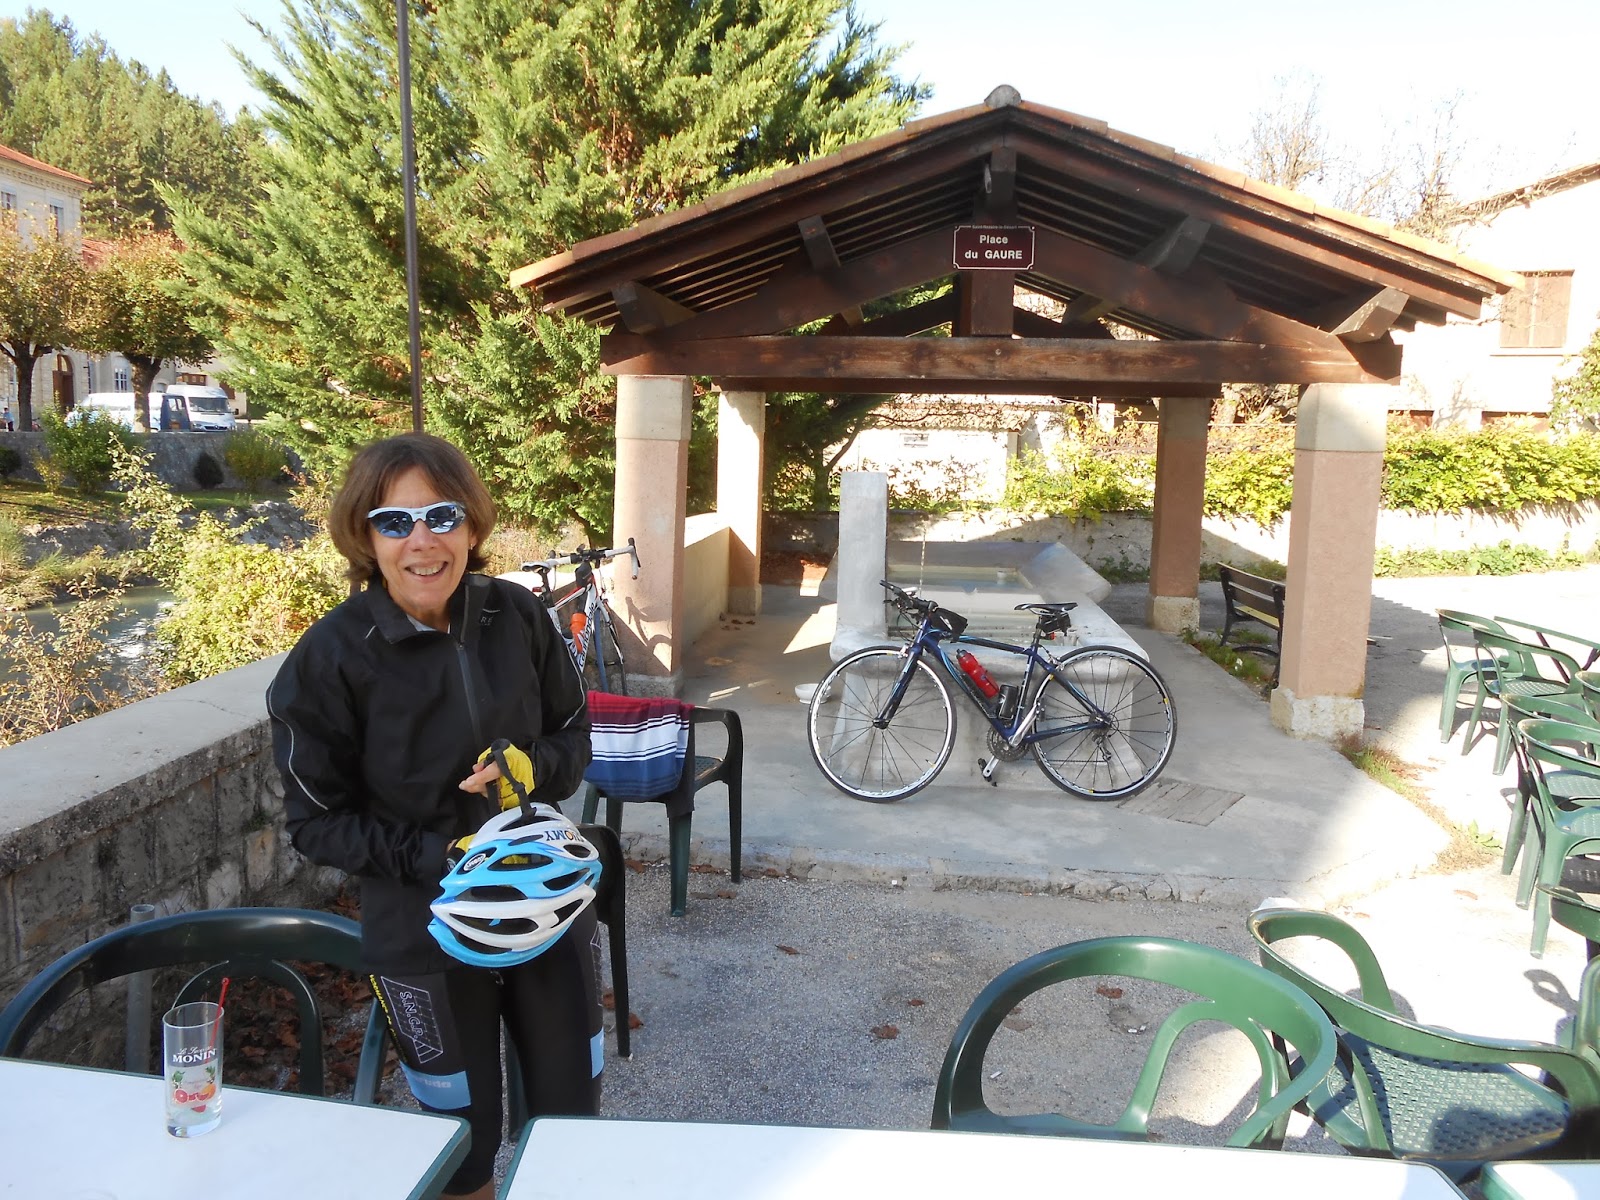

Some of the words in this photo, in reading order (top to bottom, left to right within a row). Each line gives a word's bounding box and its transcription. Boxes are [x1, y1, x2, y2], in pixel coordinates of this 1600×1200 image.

[979, 235, 1008, 244] Place
[964, 249, 979, 259] du
[985, 250, 1022, 259] GAURE
[173, 1048, 216, 1063] MONIN
